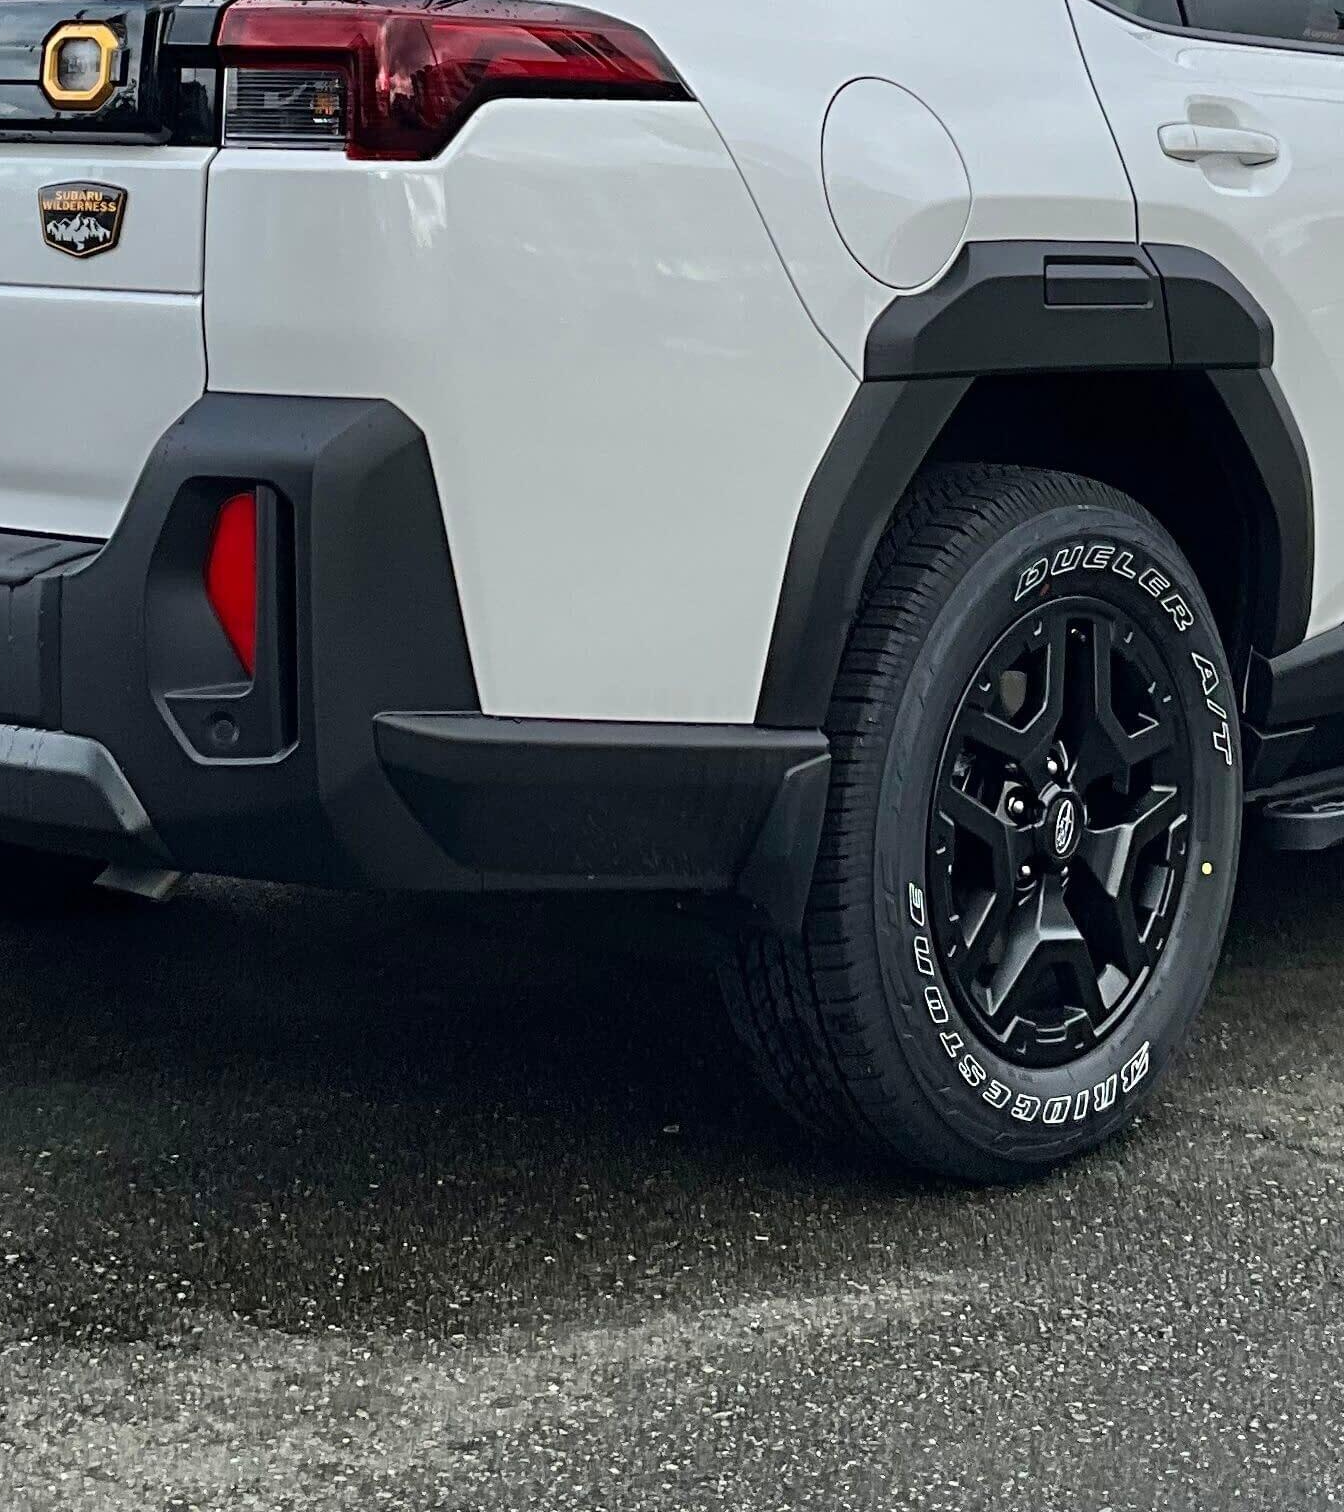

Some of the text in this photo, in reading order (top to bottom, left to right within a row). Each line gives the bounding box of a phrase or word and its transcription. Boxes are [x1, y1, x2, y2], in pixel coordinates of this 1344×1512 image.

[42, 200, 117, 213] WILDERNESS
[55, 189, 104, 202] SUBARU
[1013, 544, 1233, 767] DUELER A/T
[908, 881, 1151, 1125] BRIDGESTONE
